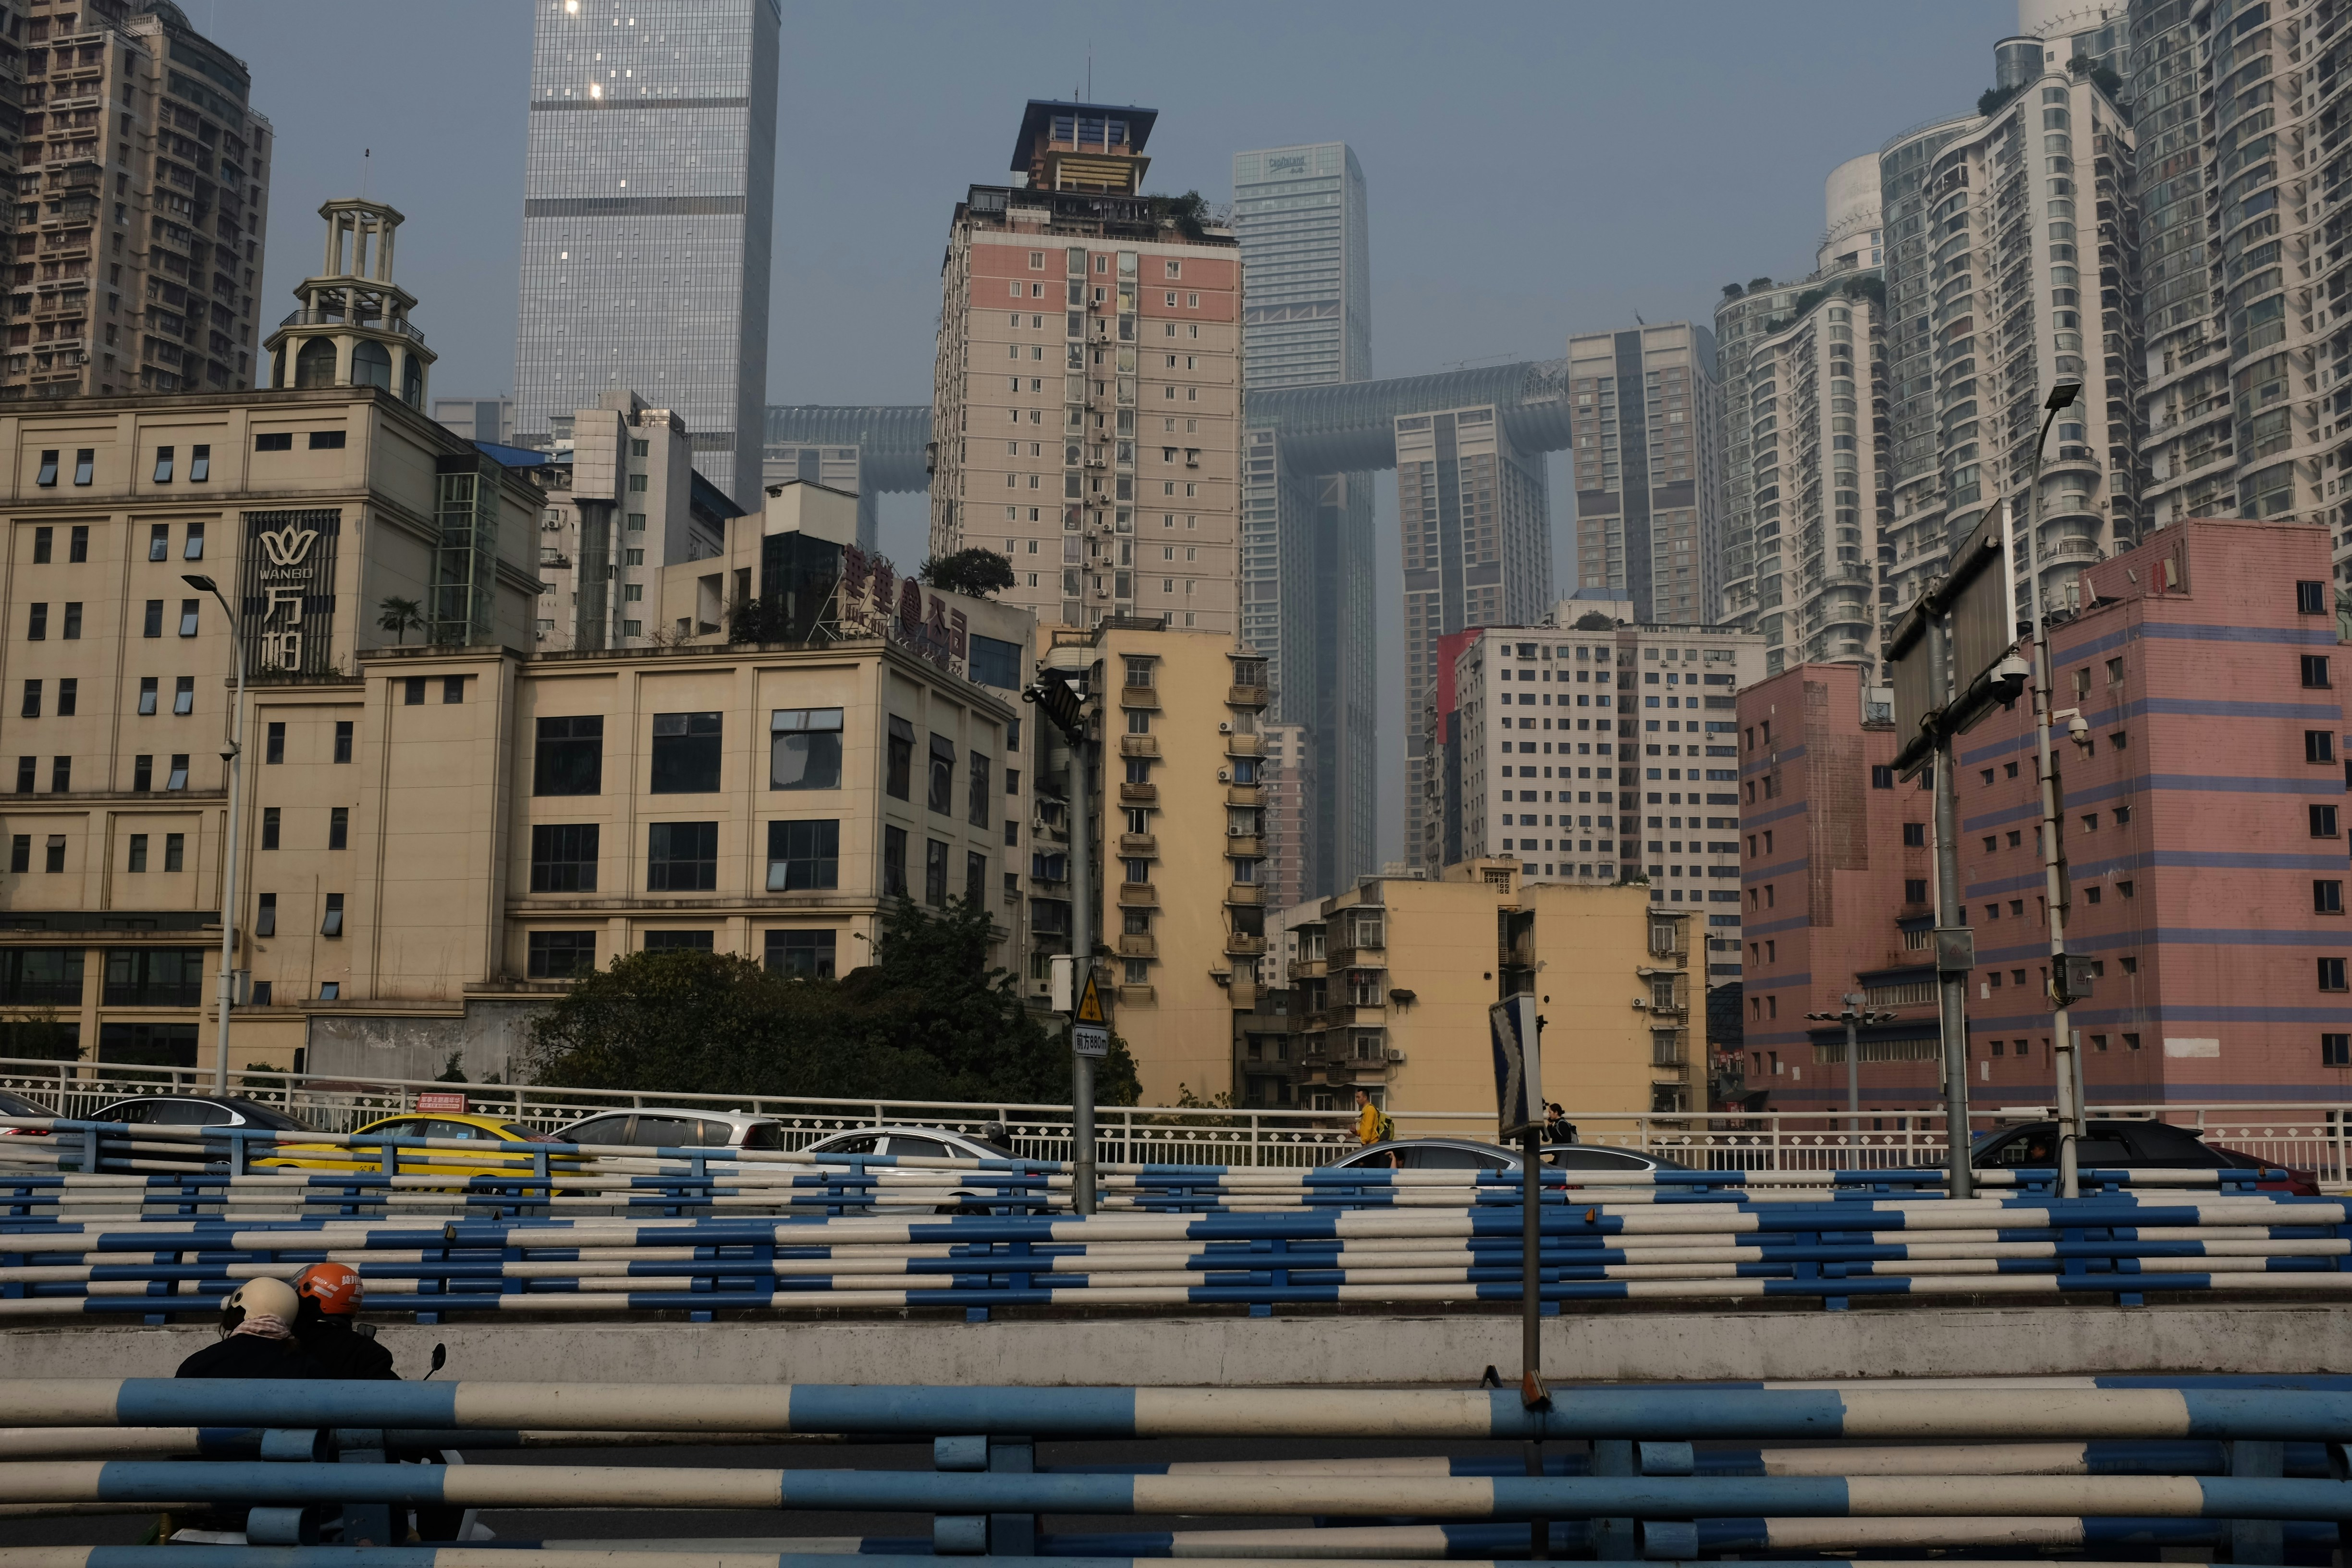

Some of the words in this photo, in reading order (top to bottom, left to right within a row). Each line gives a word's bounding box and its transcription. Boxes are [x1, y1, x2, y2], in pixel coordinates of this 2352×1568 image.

[260, 568, 313, 580] WANBO
[261, 585, 306, 671] 万柏
[927, 594, 967, 660] 公司
[1076, 1032, 1107, 1050] 前方880m
